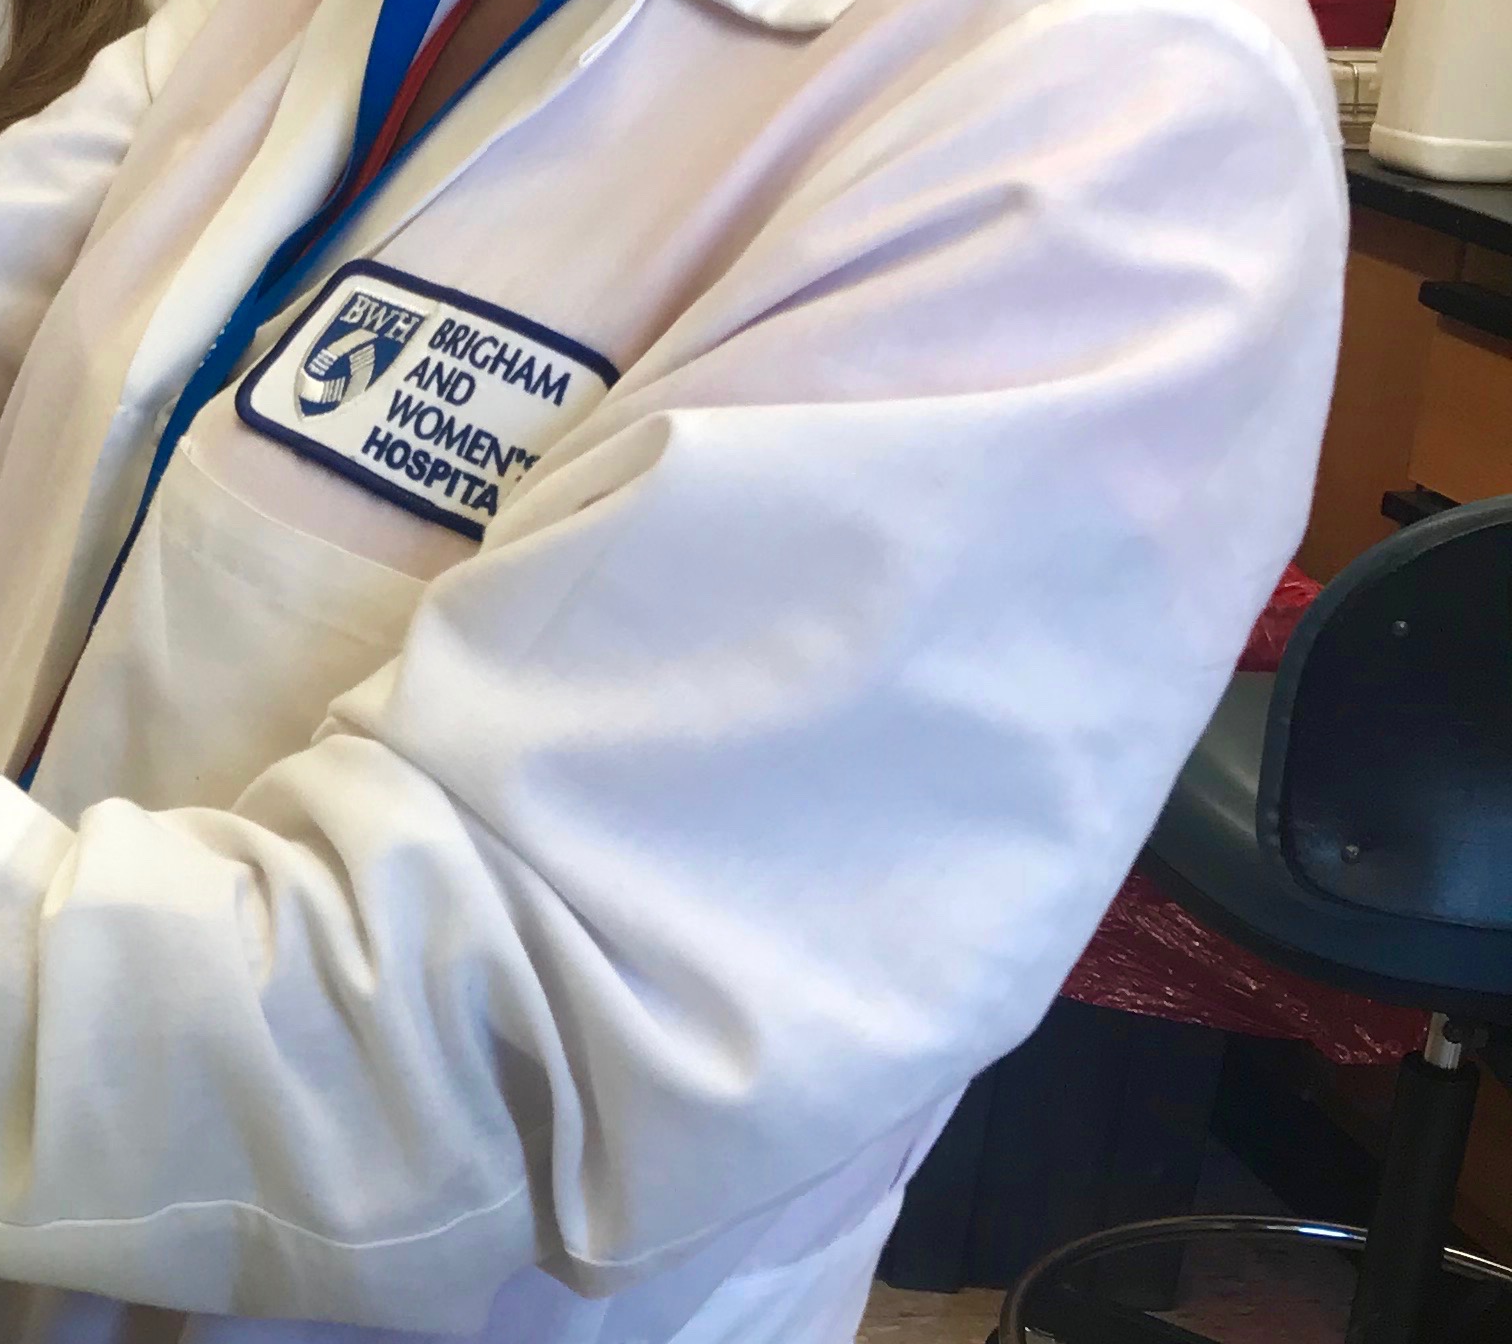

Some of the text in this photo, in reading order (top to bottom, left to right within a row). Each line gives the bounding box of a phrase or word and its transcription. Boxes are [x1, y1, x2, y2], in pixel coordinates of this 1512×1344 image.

[340, 294, 421, 344] BWH
[404, 356, 477, 407] AND
[427, 317, 573, 407] BRIGHAM
[361, 425, 499, 517] HOSPITA
